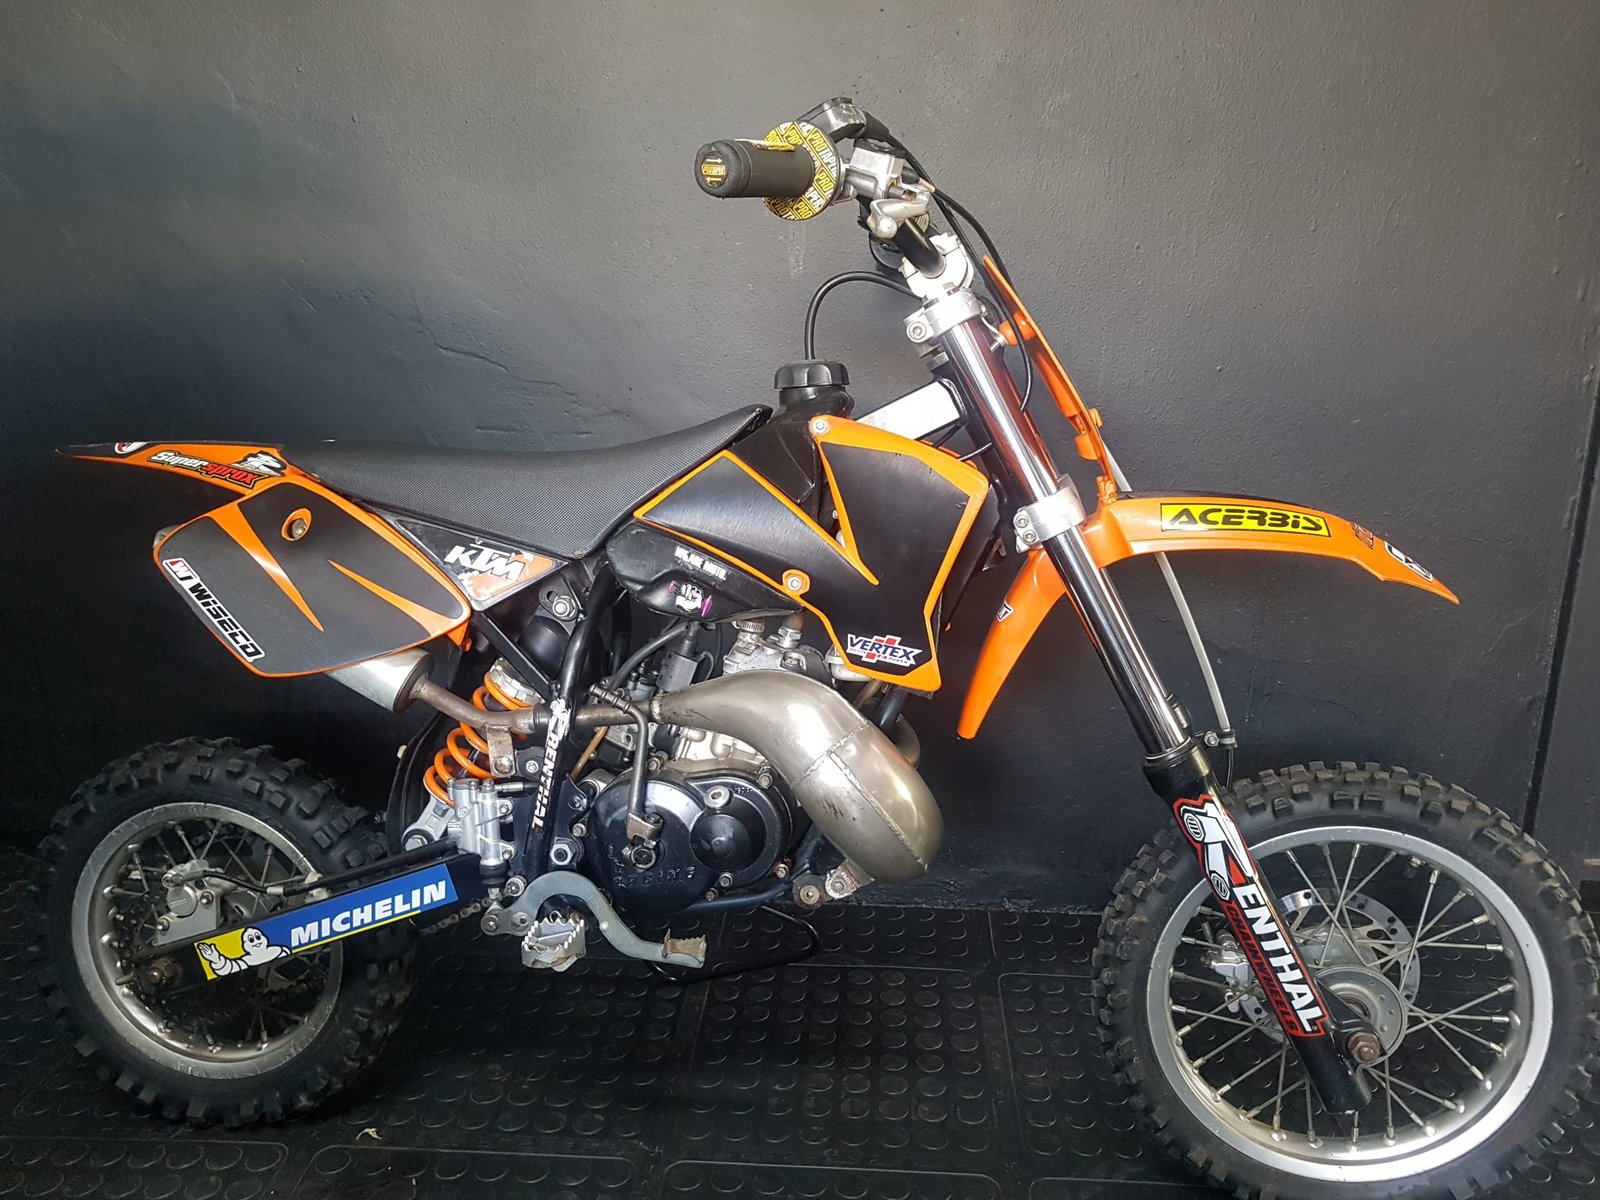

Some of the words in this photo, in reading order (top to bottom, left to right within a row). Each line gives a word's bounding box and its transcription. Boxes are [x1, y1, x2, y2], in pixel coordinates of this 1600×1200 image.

[443, 543, 526, 581] KTM
[849, 635, 915, 662] VERTEX
[532, 732, 560, 829] RENTHAL
[290, 880, 447, 948] MICHELIN
[1228, 904, 1299, 1033] CHAINWHEELS
